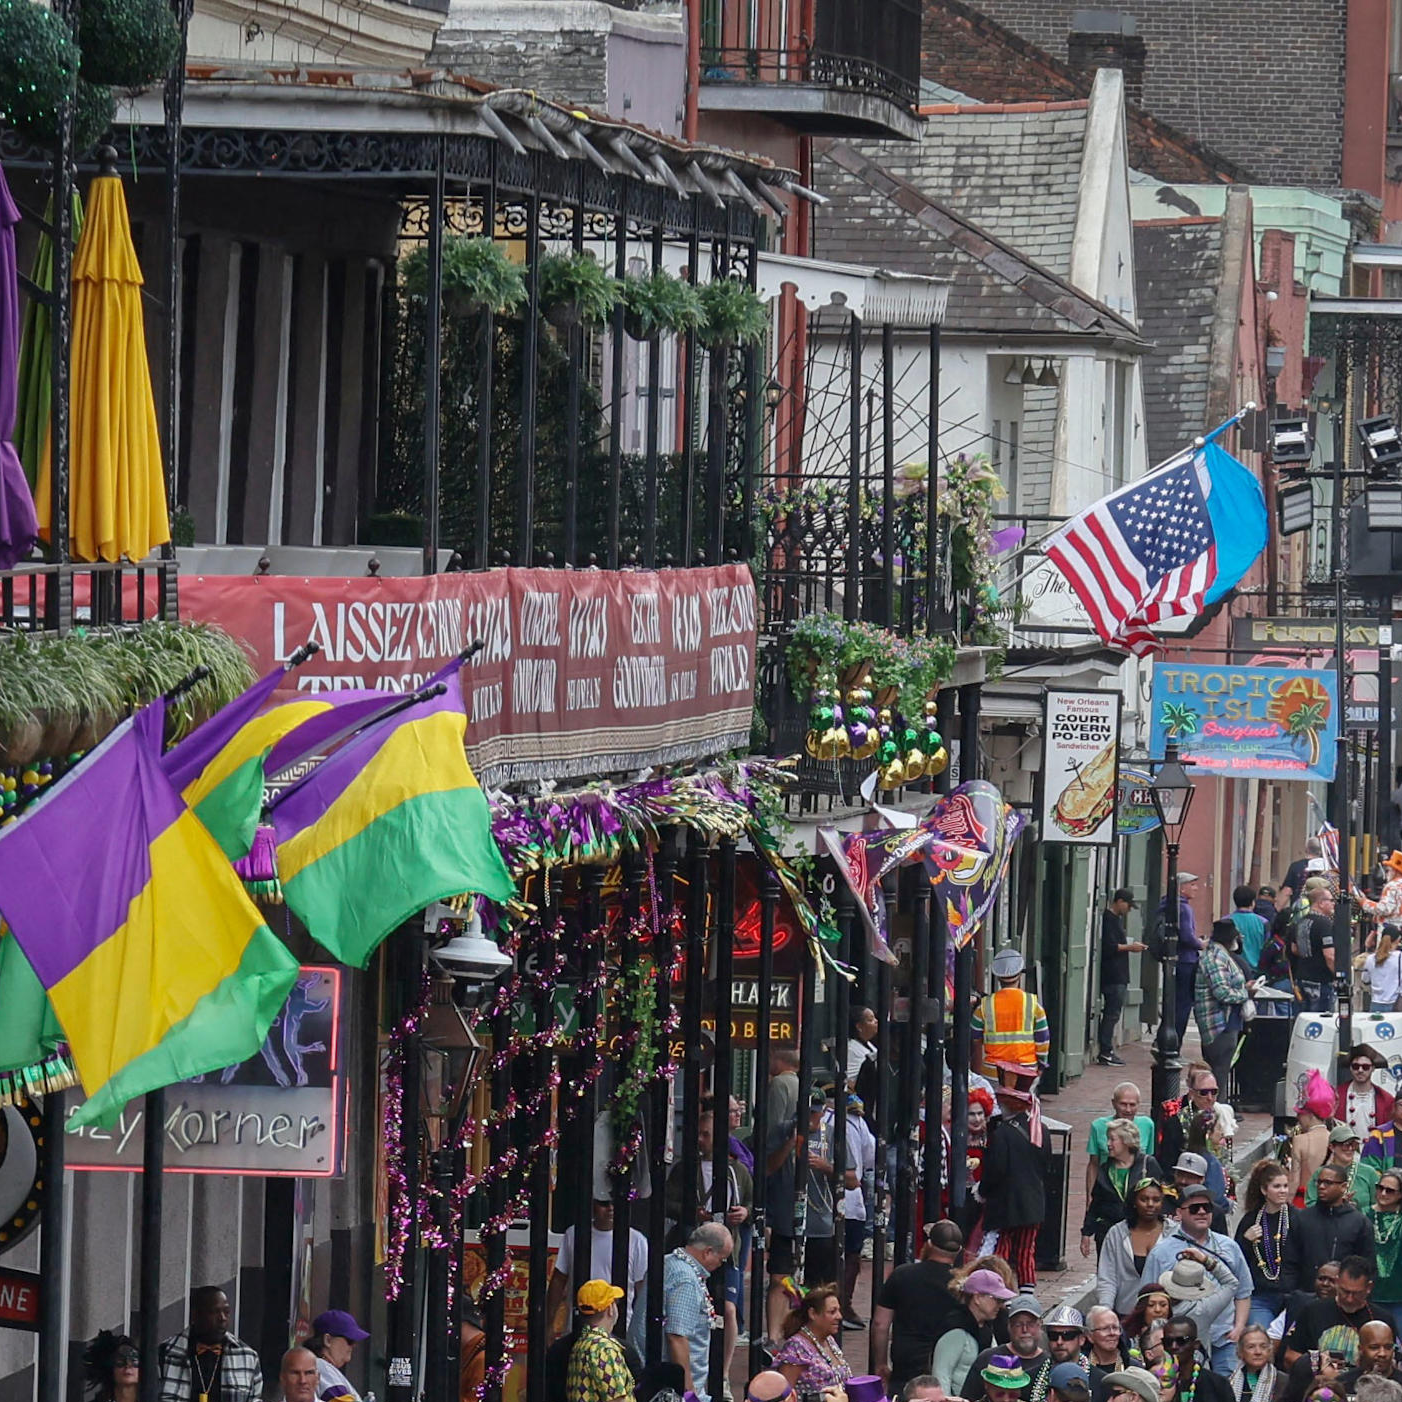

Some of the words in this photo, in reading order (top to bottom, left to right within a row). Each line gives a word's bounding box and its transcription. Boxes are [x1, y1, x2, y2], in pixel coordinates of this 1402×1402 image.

[1033, 569, 1066, 598] The
[273, 601, 417, 663] LAISSEZ
[1163, 671, 1329, 700] TROPICAL
[1078, 698, 1109, 707] Orleans
[1067, 706, 1099, 714] Famous
[1203, 699, 1286, 721] ISLE
[1055, 714, 1109, 723] COURT
[1052, 723, 1111, 733] TAVERN
[1202, 721, 1280, 741] Original
[1052, 732, 1112, 742] PO-BOY
[1056, 742, 1100, 750] Sandwiches
[744, 1022, 791, 1039] BER
